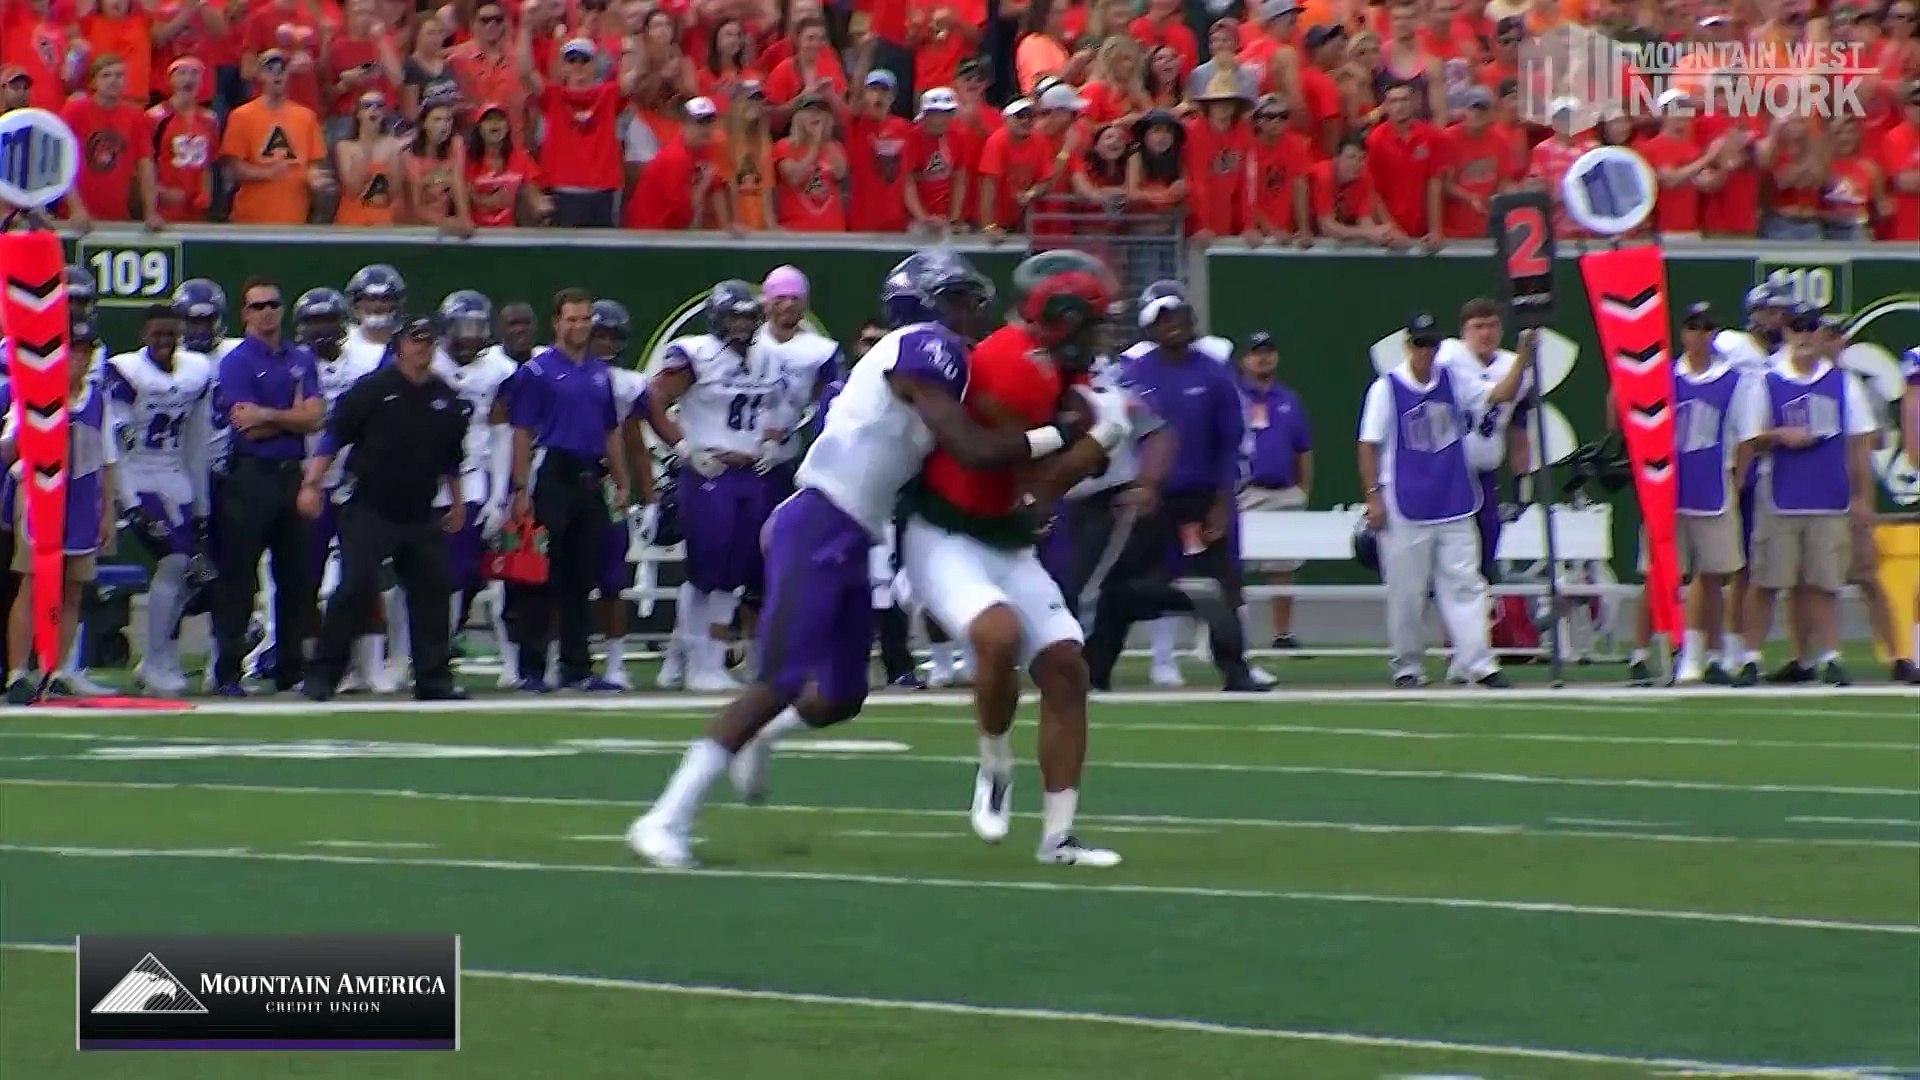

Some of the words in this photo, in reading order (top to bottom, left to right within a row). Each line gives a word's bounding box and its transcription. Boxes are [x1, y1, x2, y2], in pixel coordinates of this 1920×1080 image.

[262, 126, 298, 160] A
[1504, 207, 1550, 277] 2
[91, 249, 169, 297] 109
